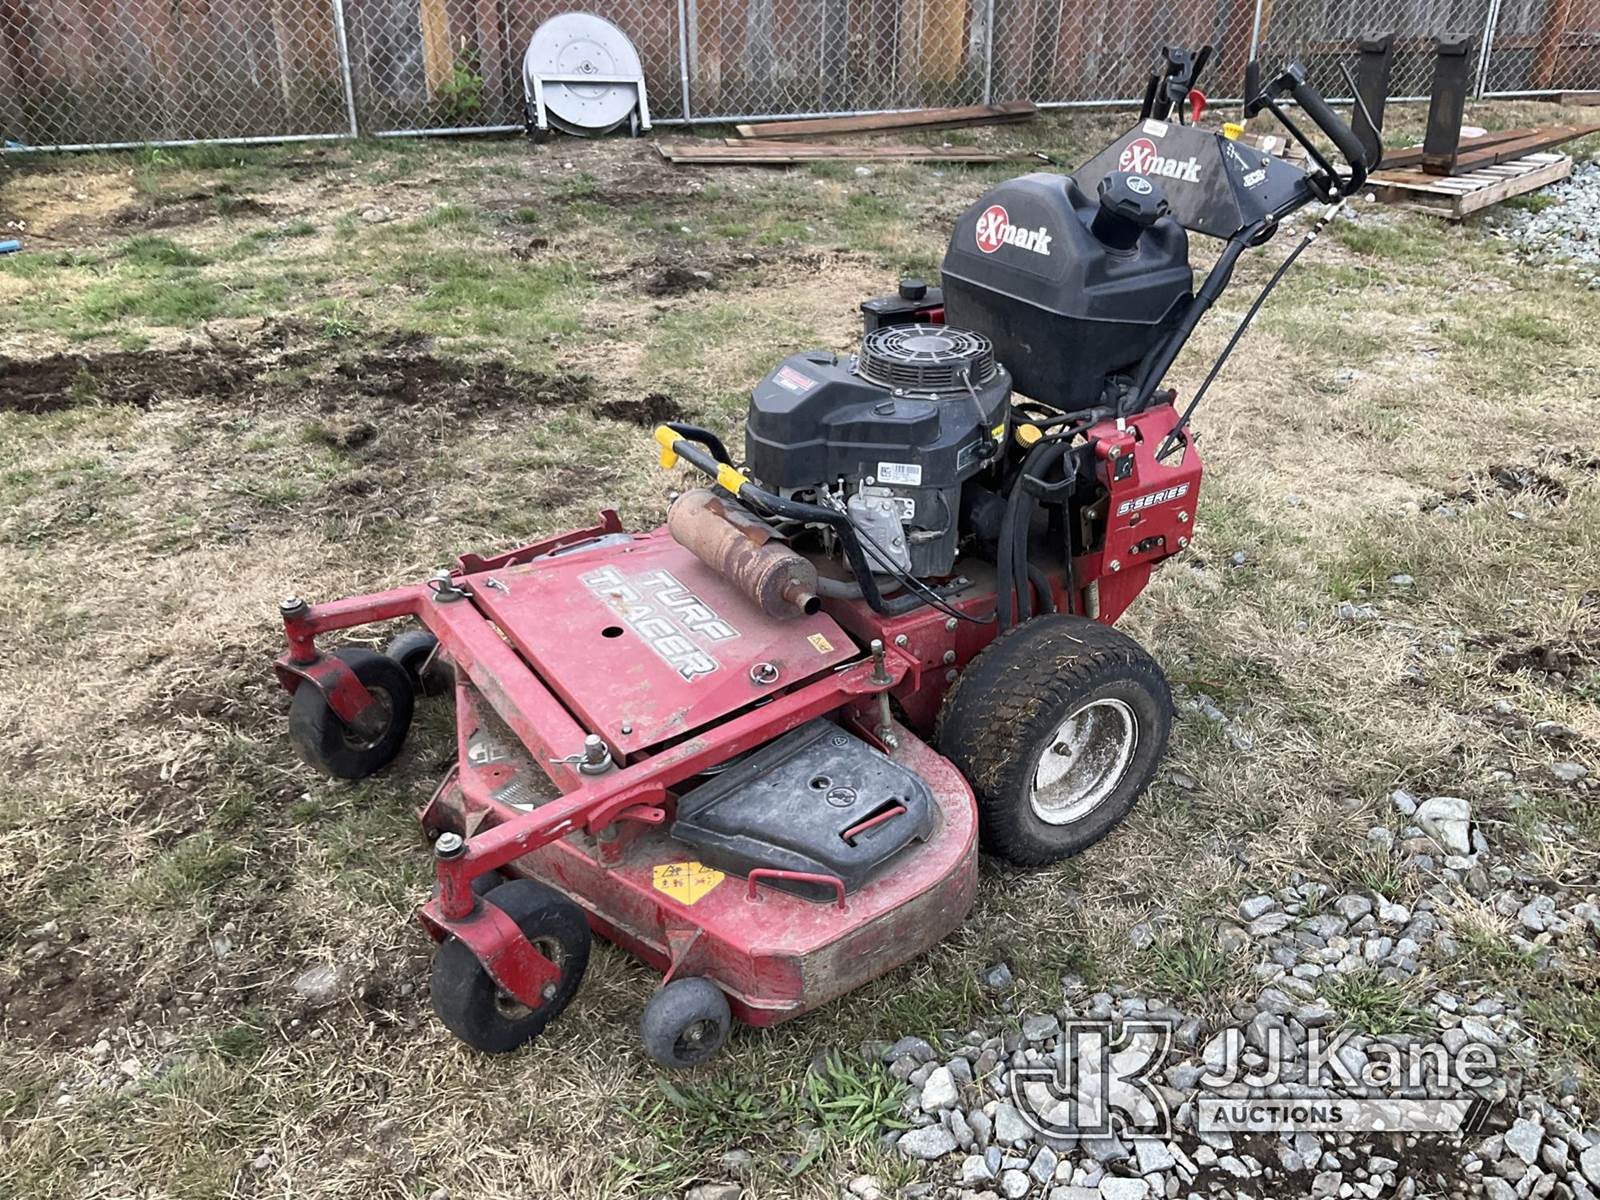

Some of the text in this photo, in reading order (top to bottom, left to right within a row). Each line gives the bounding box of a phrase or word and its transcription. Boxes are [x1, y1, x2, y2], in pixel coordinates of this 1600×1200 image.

[1117, 483, 1190, 515] S-SERIES
[578, 566, 719, 682] TRACER
[643, 569, 741, 641] TURF
